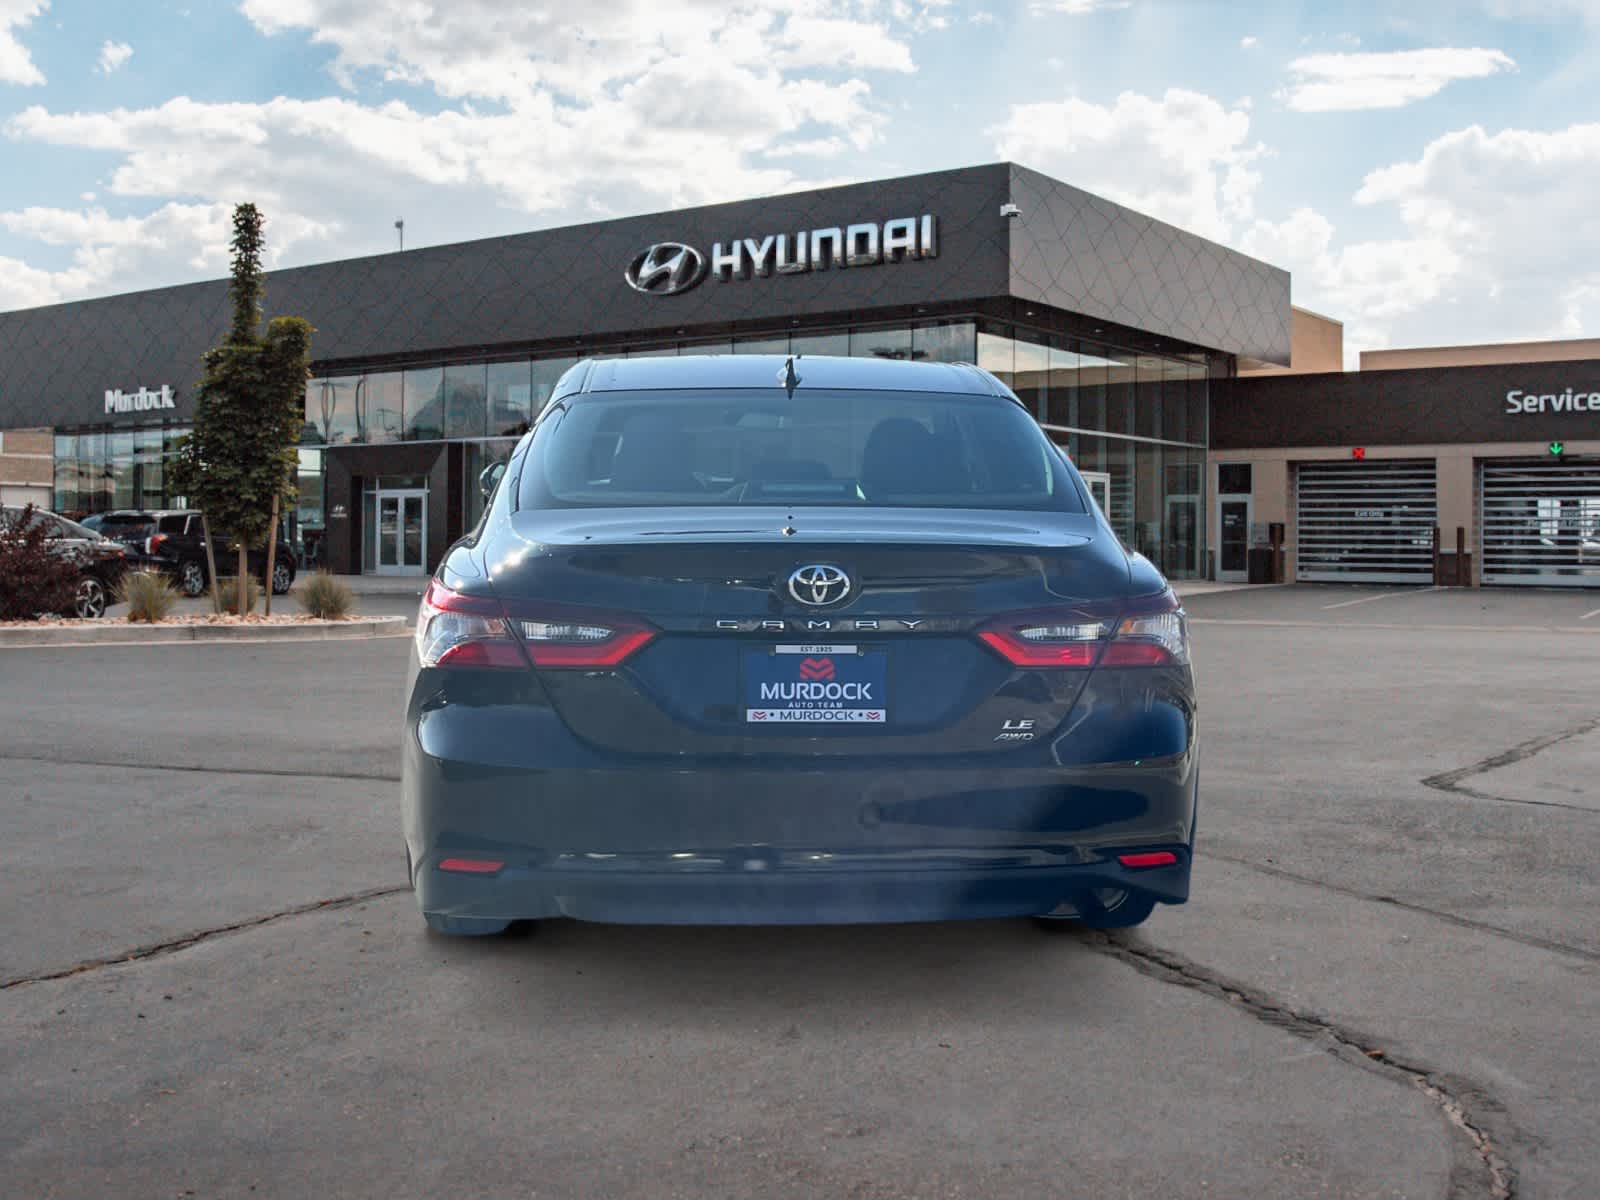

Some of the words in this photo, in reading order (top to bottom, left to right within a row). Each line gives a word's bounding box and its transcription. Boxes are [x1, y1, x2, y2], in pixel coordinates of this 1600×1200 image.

[712, 214, 937, 282] HYUNDAI
[104, 384, 176, 414] Murdock
[1505, 387, 1600, 413] Service
[716, 619, 924, 629] CAMRY
[760, 682, 873, 700] MURDOCK
[779, 711, 855, 721] MURDOCK
[1001, 719, 1035, 730] LE
[993, 732, 1034, 742] AWD
